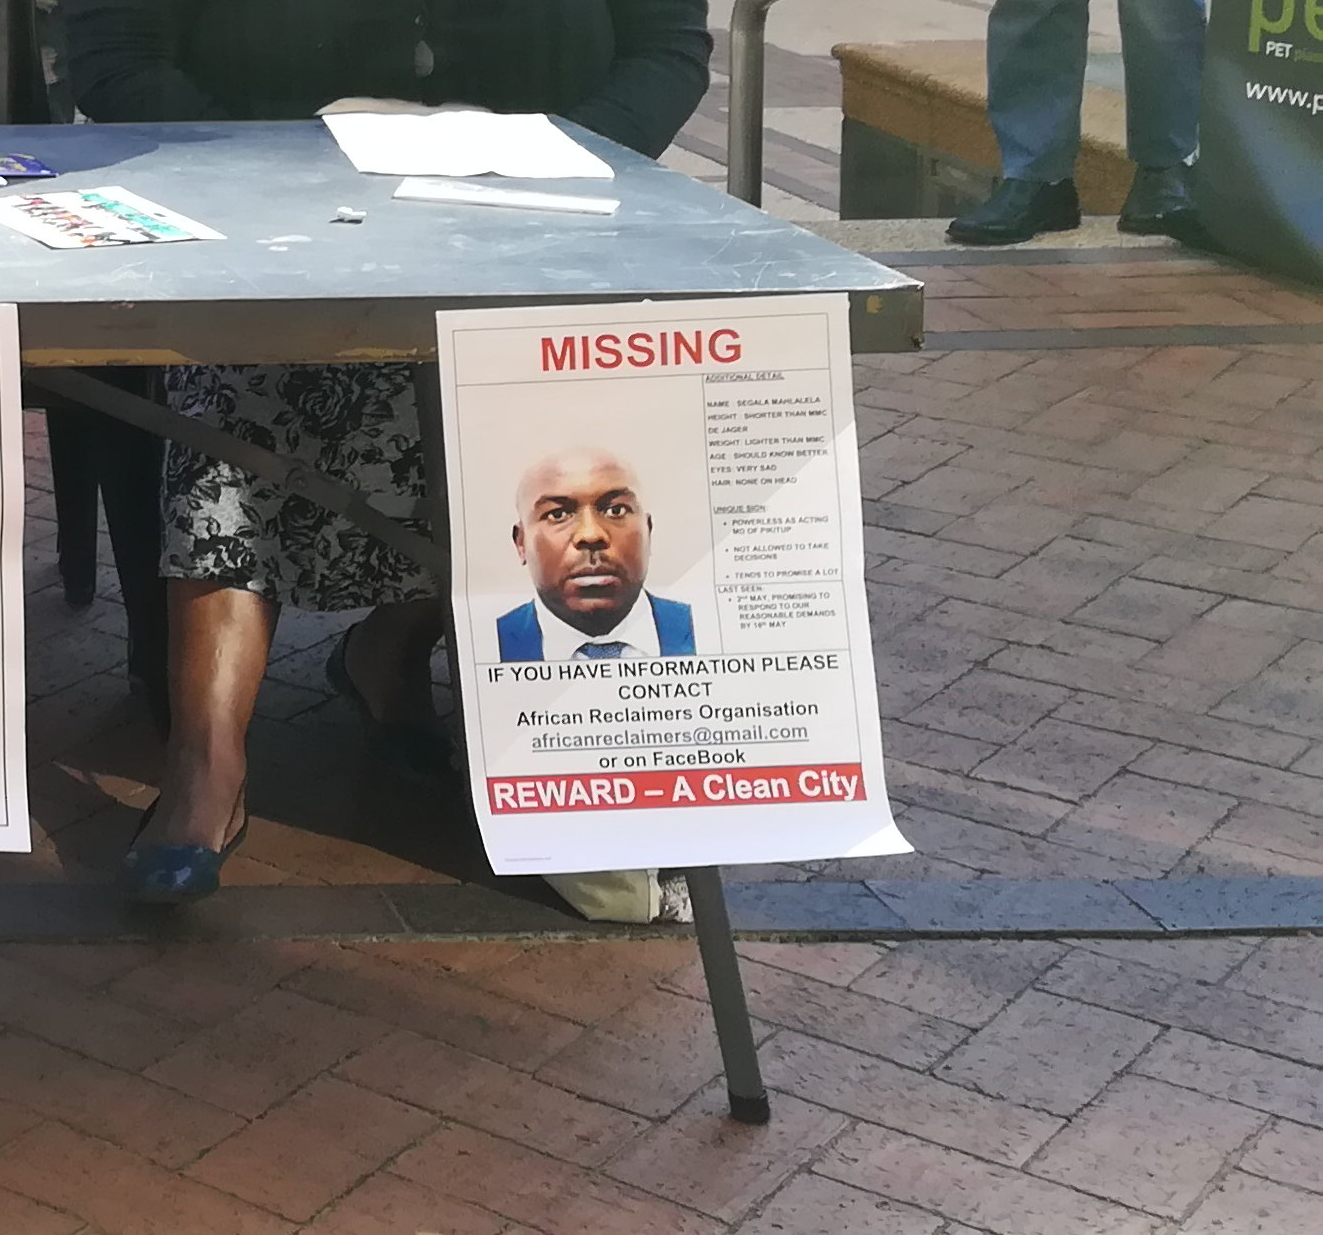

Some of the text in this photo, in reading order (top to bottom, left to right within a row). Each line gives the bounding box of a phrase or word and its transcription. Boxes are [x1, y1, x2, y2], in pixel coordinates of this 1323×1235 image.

[1266, 41, 1293, 58] PET
[542, 329, 741, 371] MISSING
[489, 655, 838, 682] IF YOU HAVE INFORMATION PLEASE
[619, 682, 712, 700] CONTACT
[517, 701, 818, 726] African Reclaimers Organisation
[532, 725, 807, 749] africanreclaimers@gmail.com
[599, 749, 745, 768] or on FaceBook
[494, 778, 635, 808] REWARD
[673, 776, 696, 801] A
[704, 774, 790, 800] Clean
[798, 770, 857, 800] City
